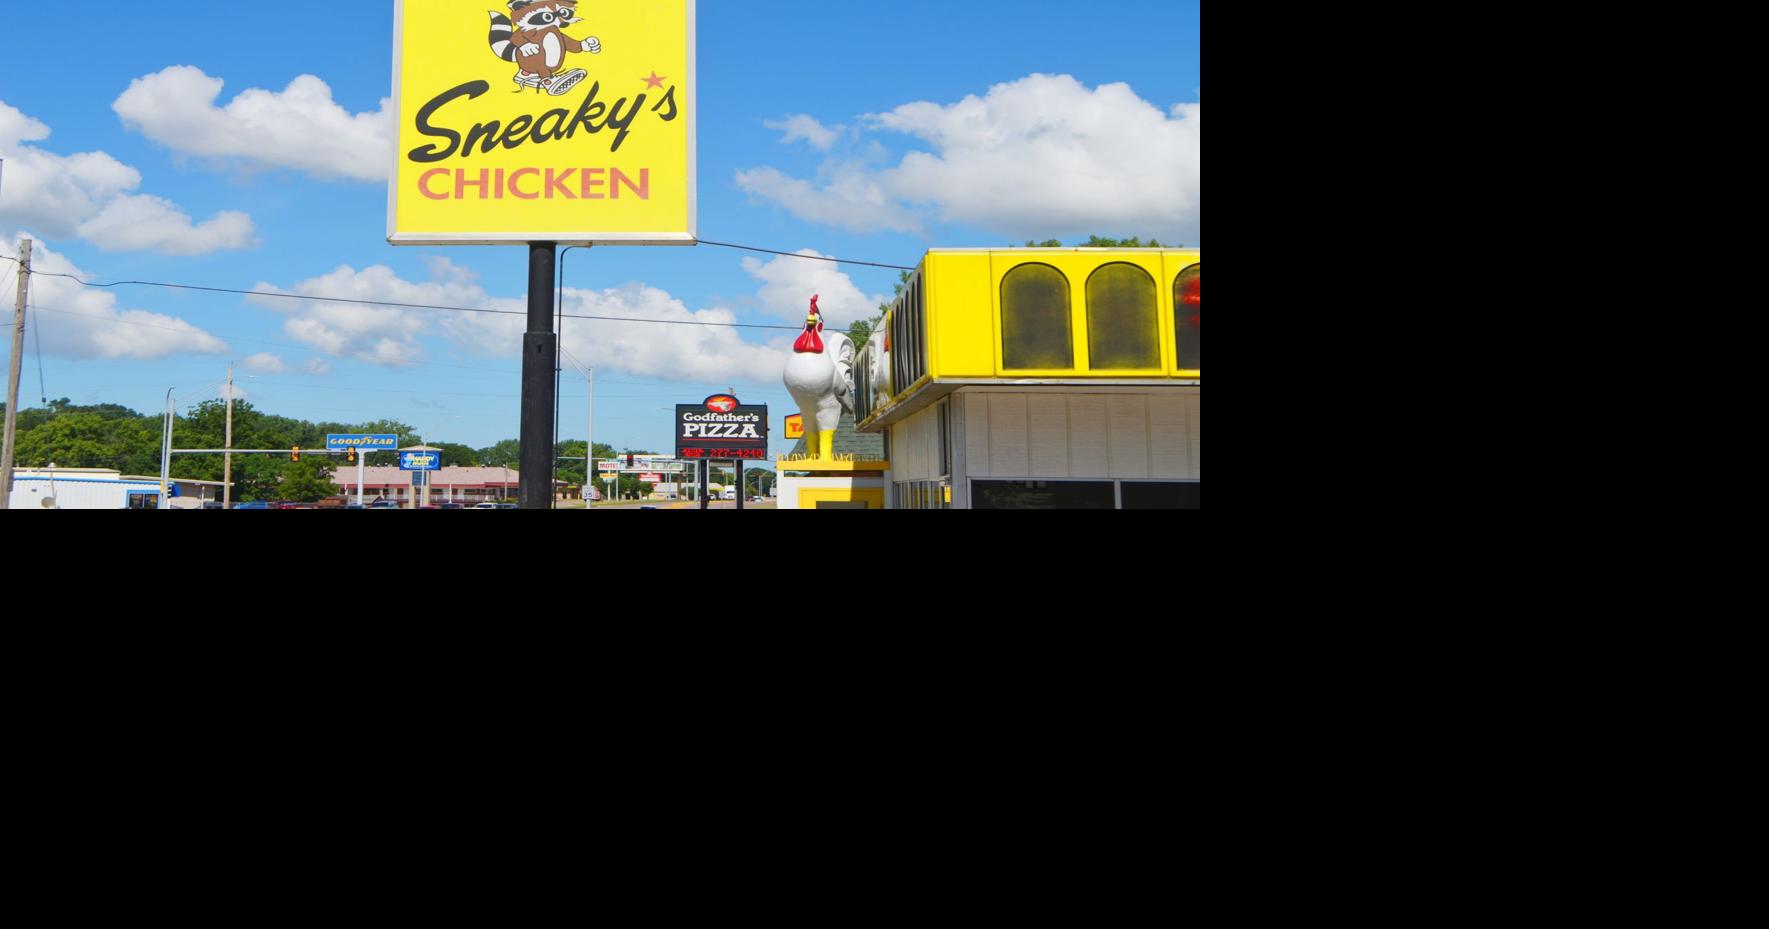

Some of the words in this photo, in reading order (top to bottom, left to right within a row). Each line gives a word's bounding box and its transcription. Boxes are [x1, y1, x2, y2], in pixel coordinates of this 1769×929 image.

[407, 72, 677, 163] Sneaky's
[418, 167, 649, 200] CHICKEN
[682, 412, 760, 422] Godfather's
[682, 423, 760, 438] PIZZA
[329, 436, 394, 446] GOODYEAR
